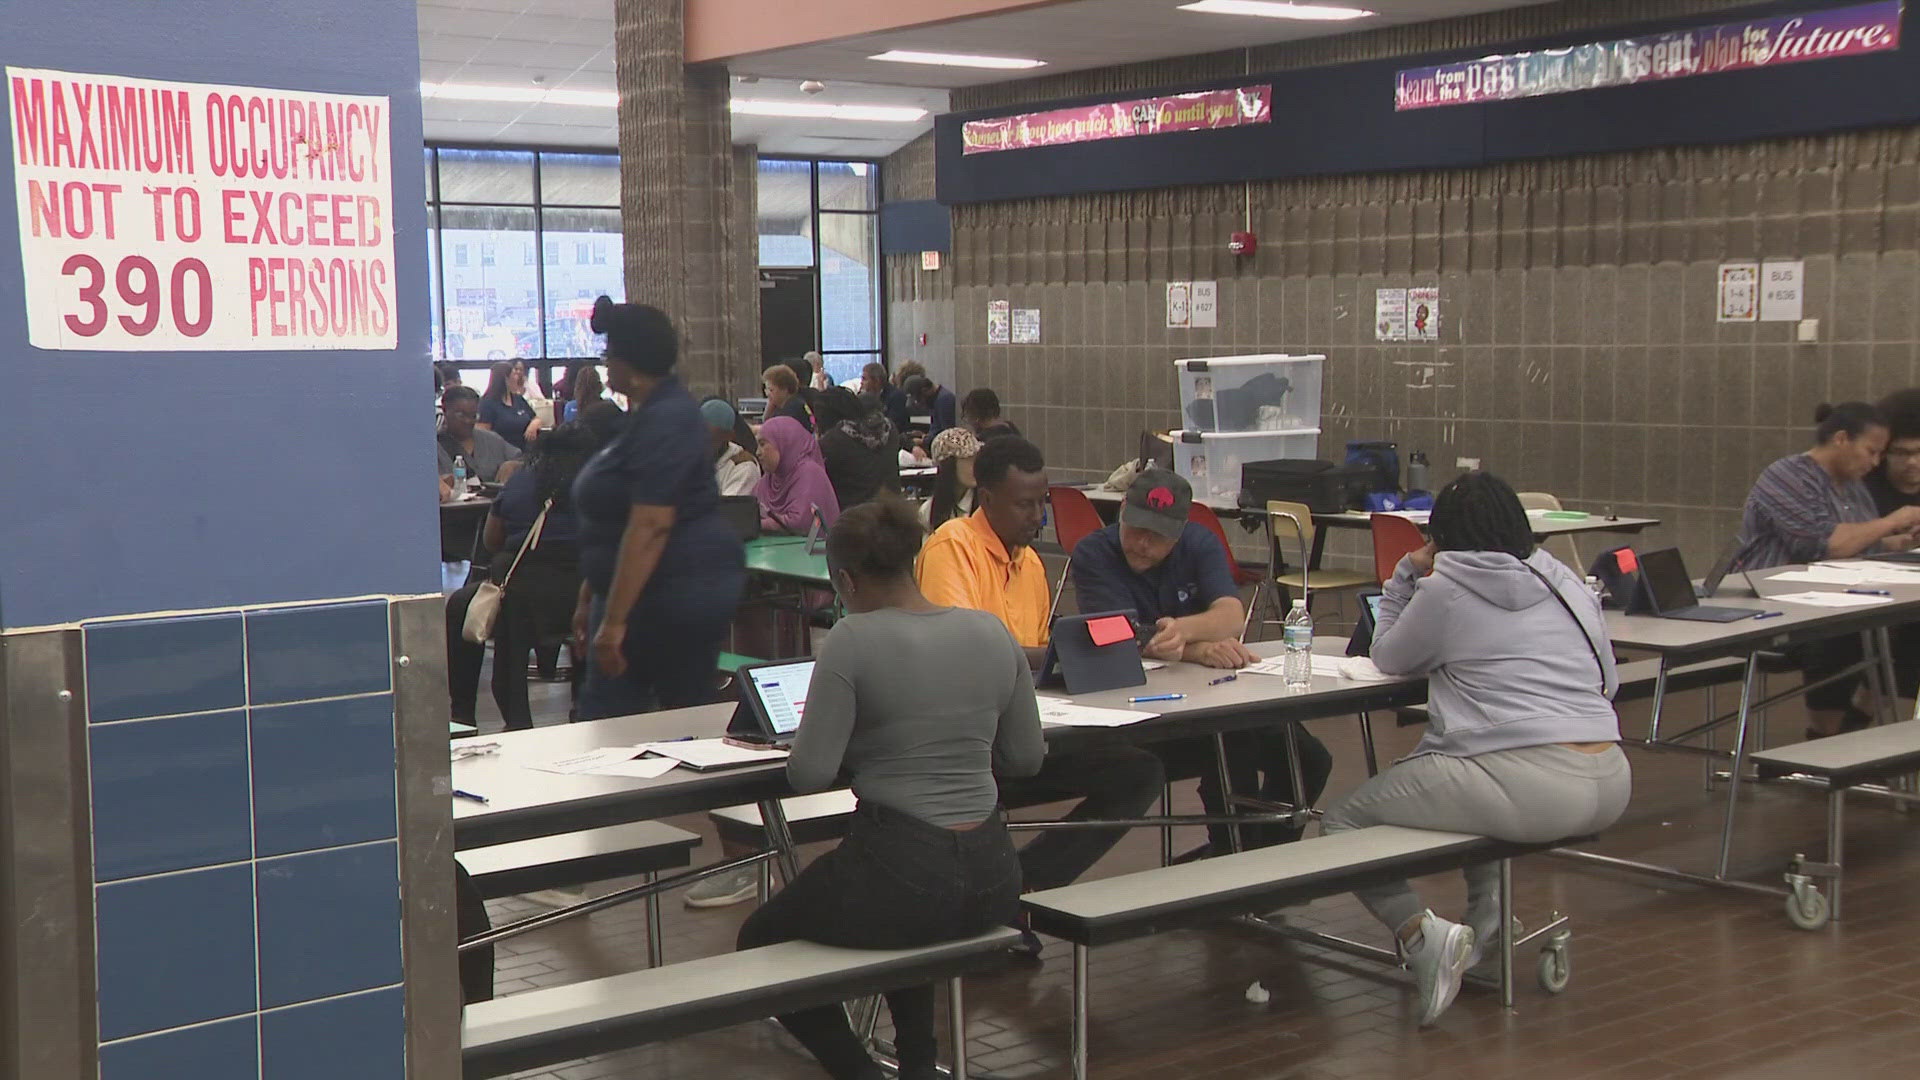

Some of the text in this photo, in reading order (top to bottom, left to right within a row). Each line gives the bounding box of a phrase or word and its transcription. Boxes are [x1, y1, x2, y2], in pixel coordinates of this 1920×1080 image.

[1743, 25, 1769, 45] for
[1703, 31, 1740, 72] plan
[1741, 44, 1769, 63] the
[1435, 68, 1465, 85] from
[1439, 84, 1461, 101] the
[1132, 103, 1157, 123] CAN
[1174, 101, 1206, 123] until
[1207, 103, 1234, 124] you
[12, 77, 380, 182] MAXIMUM OCCUPANCY
[28, 180, 381, 247] NOT TO EXCEED
[1771, 270, 1794, 281] BUS
[61, 253, 389, 337] 390 PERSONS
[1197, 287, 1211, 297] BUS
